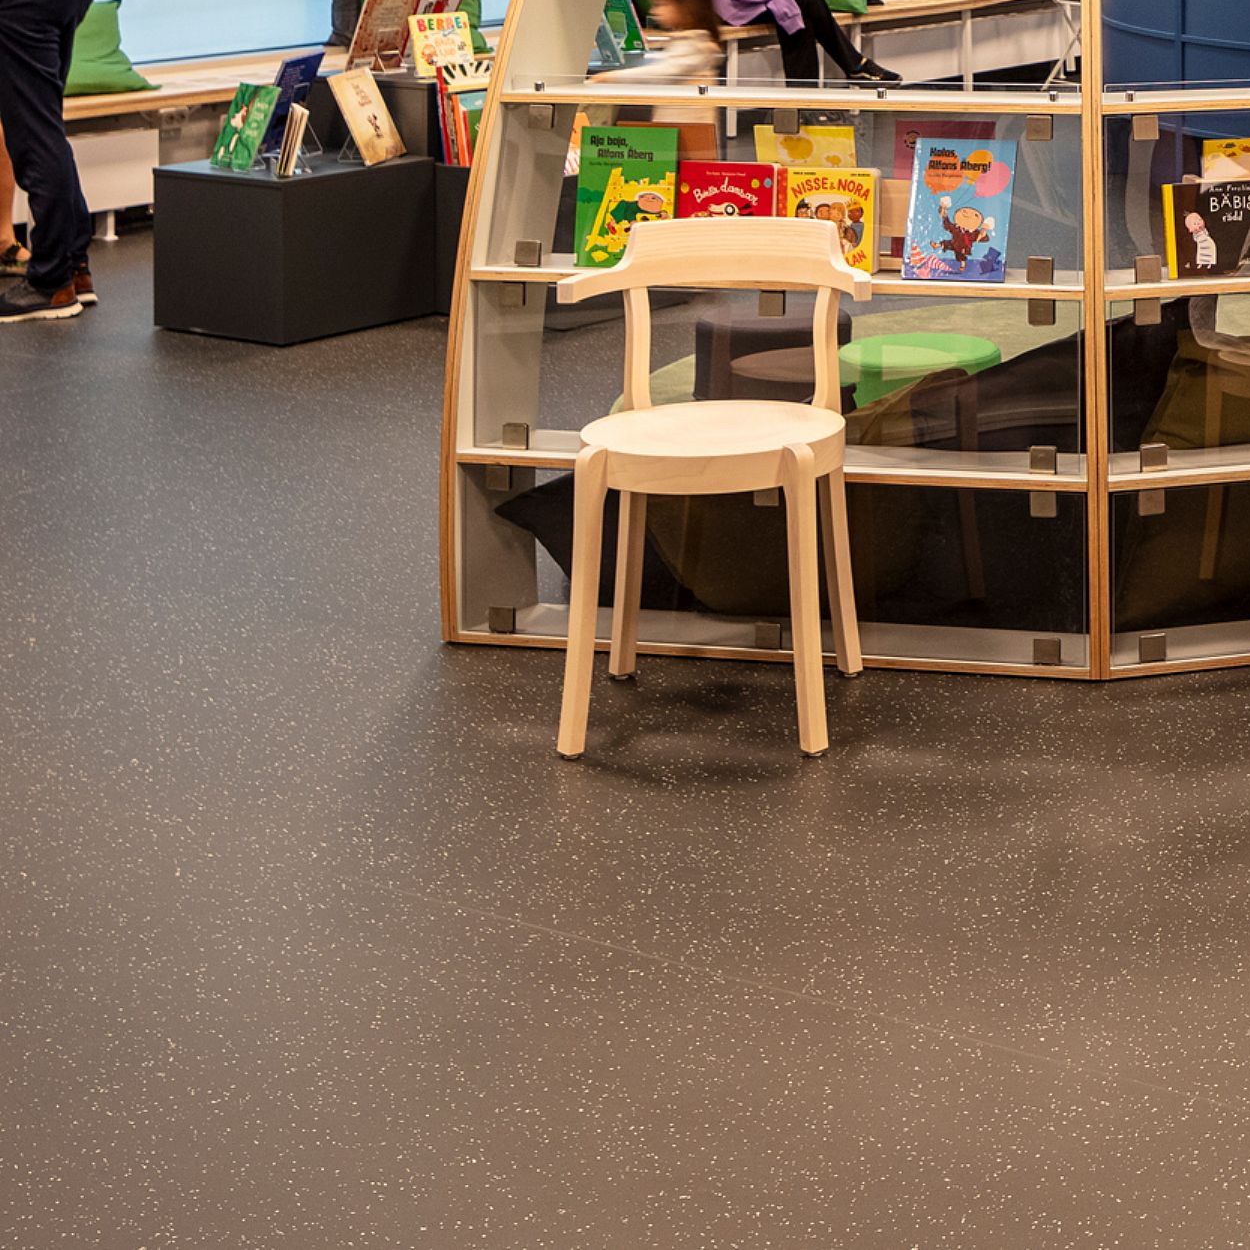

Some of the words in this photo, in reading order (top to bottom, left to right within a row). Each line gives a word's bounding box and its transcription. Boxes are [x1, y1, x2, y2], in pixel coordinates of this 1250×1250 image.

[597, 148, 625, 159] Alfons
[627, 146, 654, 162] Åberg
[928, 159, 957, 170] Alfons
[960, 157, 992, 174] Åberg!
[790, 177, 829, 199] NISSE
[837, 178, 871, 201] NORA
